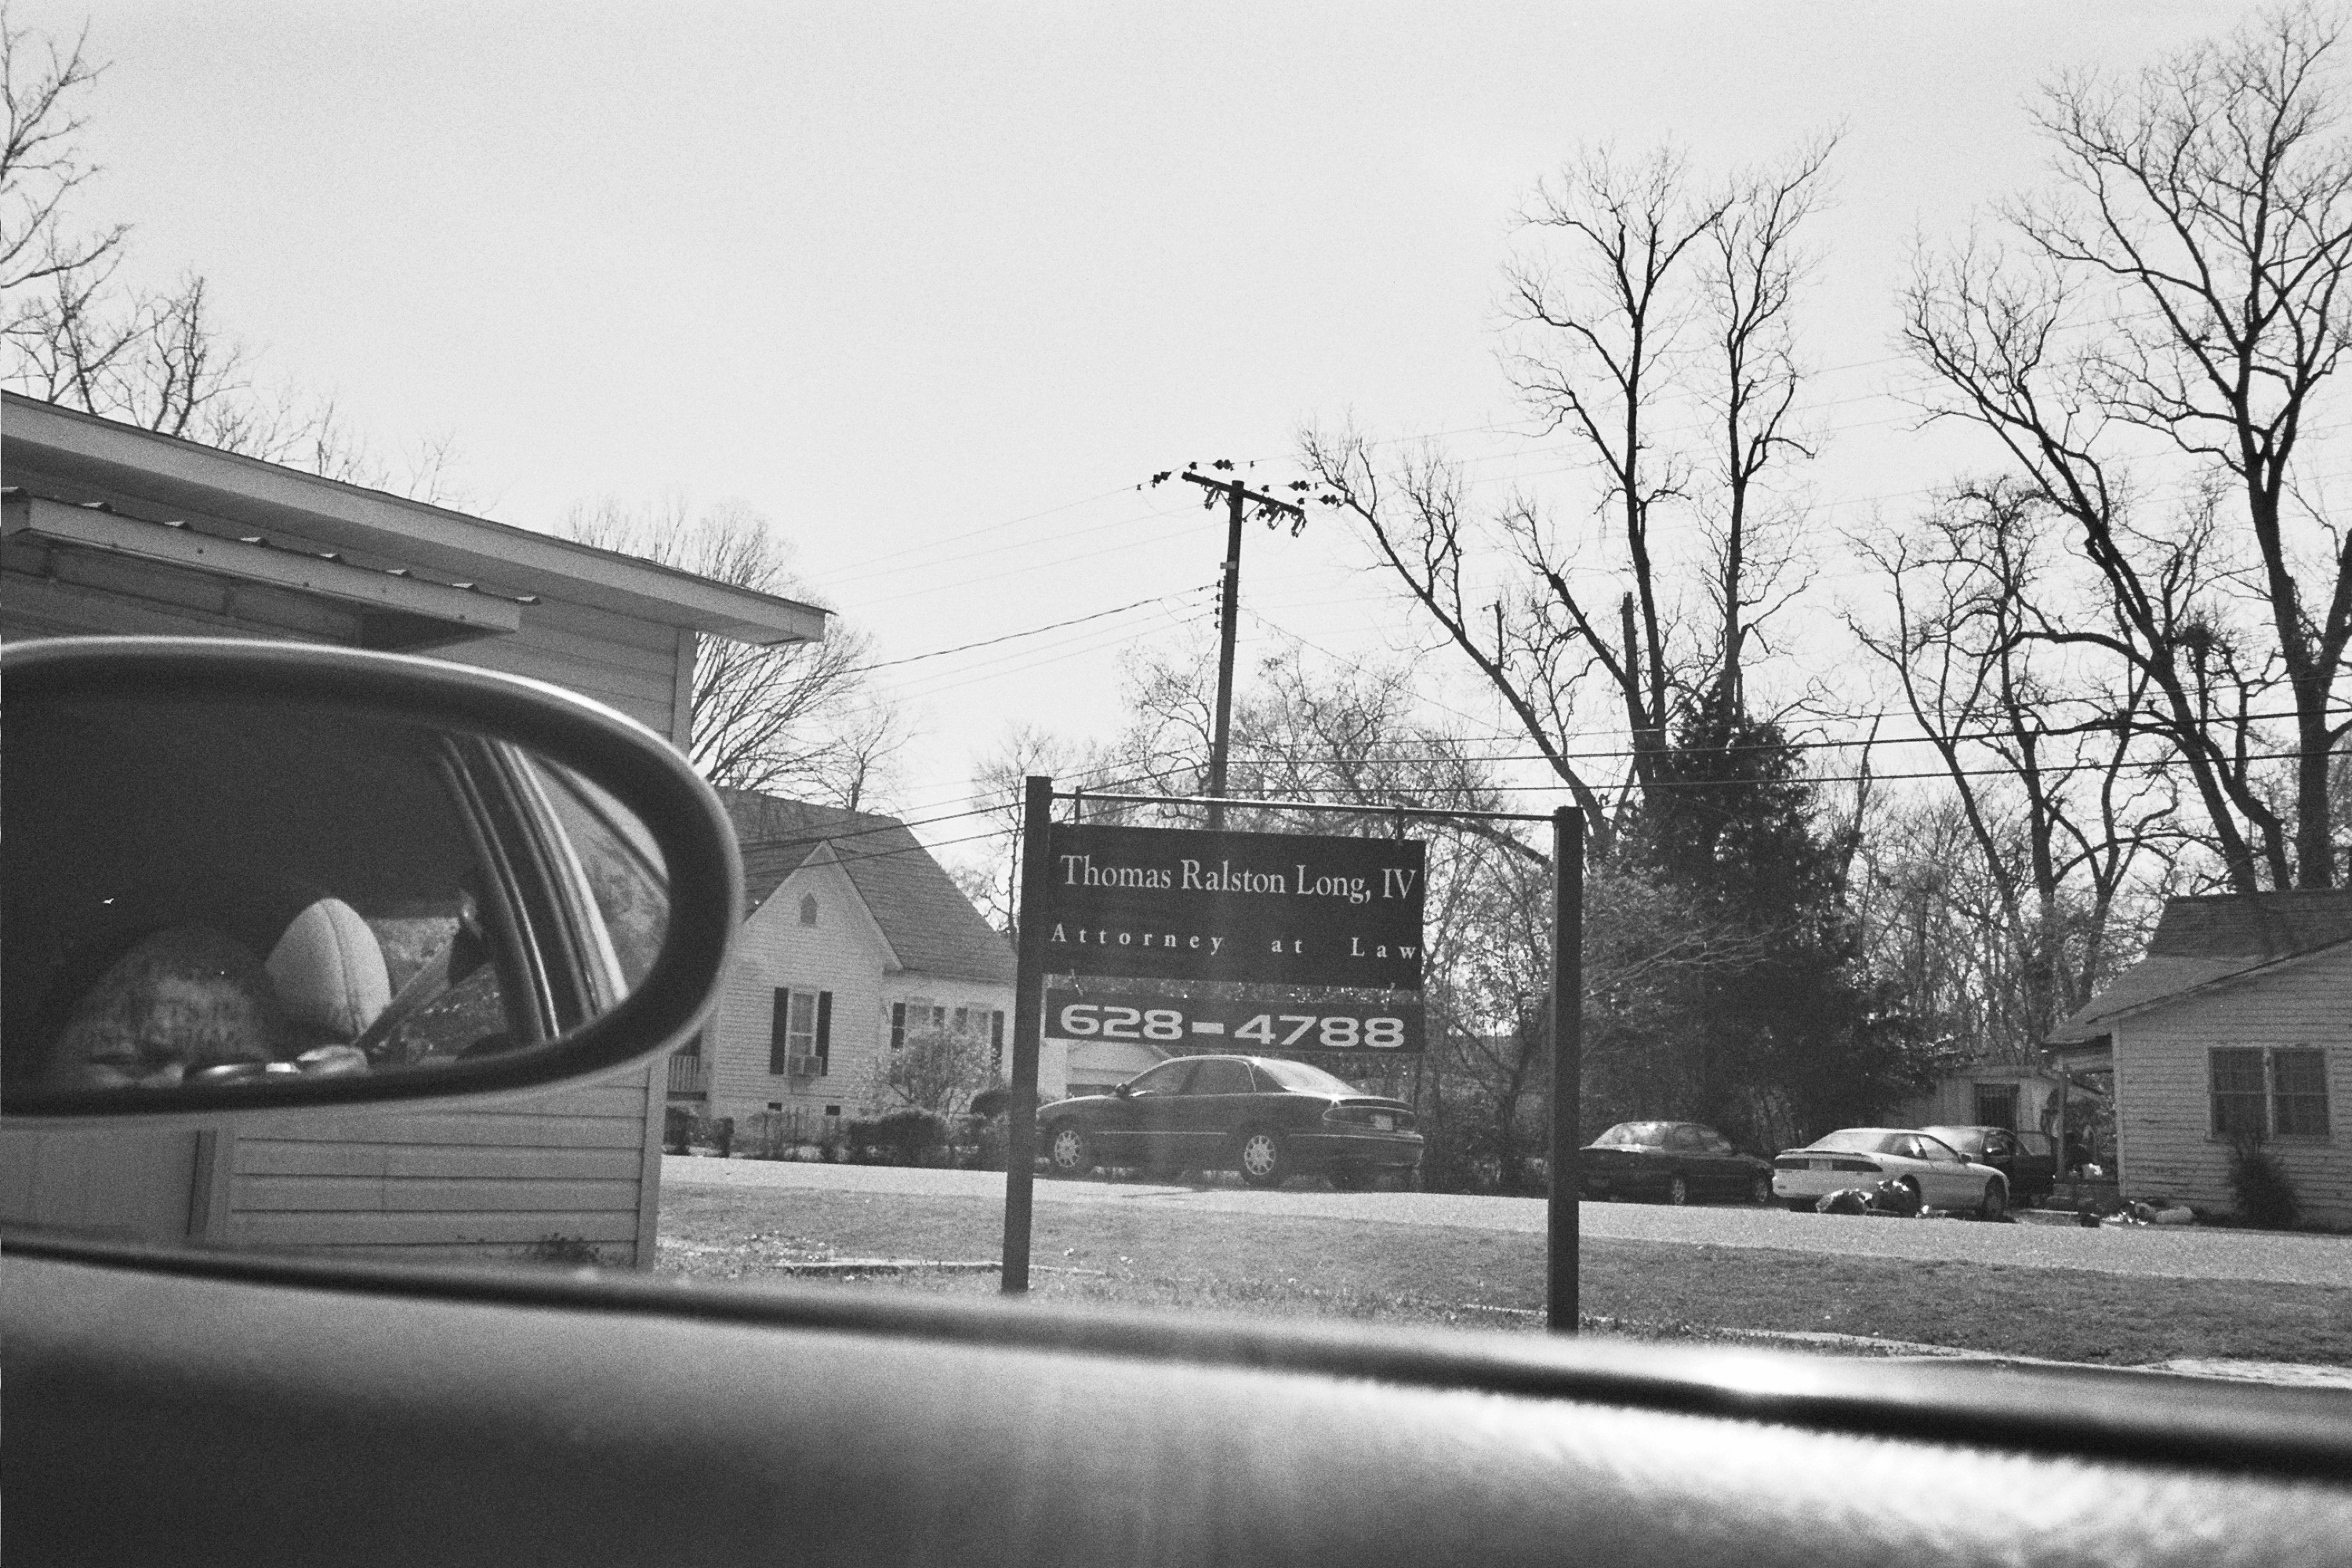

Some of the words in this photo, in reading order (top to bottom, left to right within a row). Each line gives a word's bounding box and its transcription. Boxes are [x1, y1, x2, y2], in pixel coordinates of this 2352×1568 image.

[1060, 855, 1171, 889] Thomas
[1181, 859, 1287, 894] Ralston
[1296, 864, 1371, 904] Long,
[1382, 868, 1417, 898] IV
[1051, 923, 1223, 955] Attorney
[1271, 938, 1302, 953] at
[1350, 937, 1417, 959] Law
[1060, 1004, 1405, 1048] 628-4788
